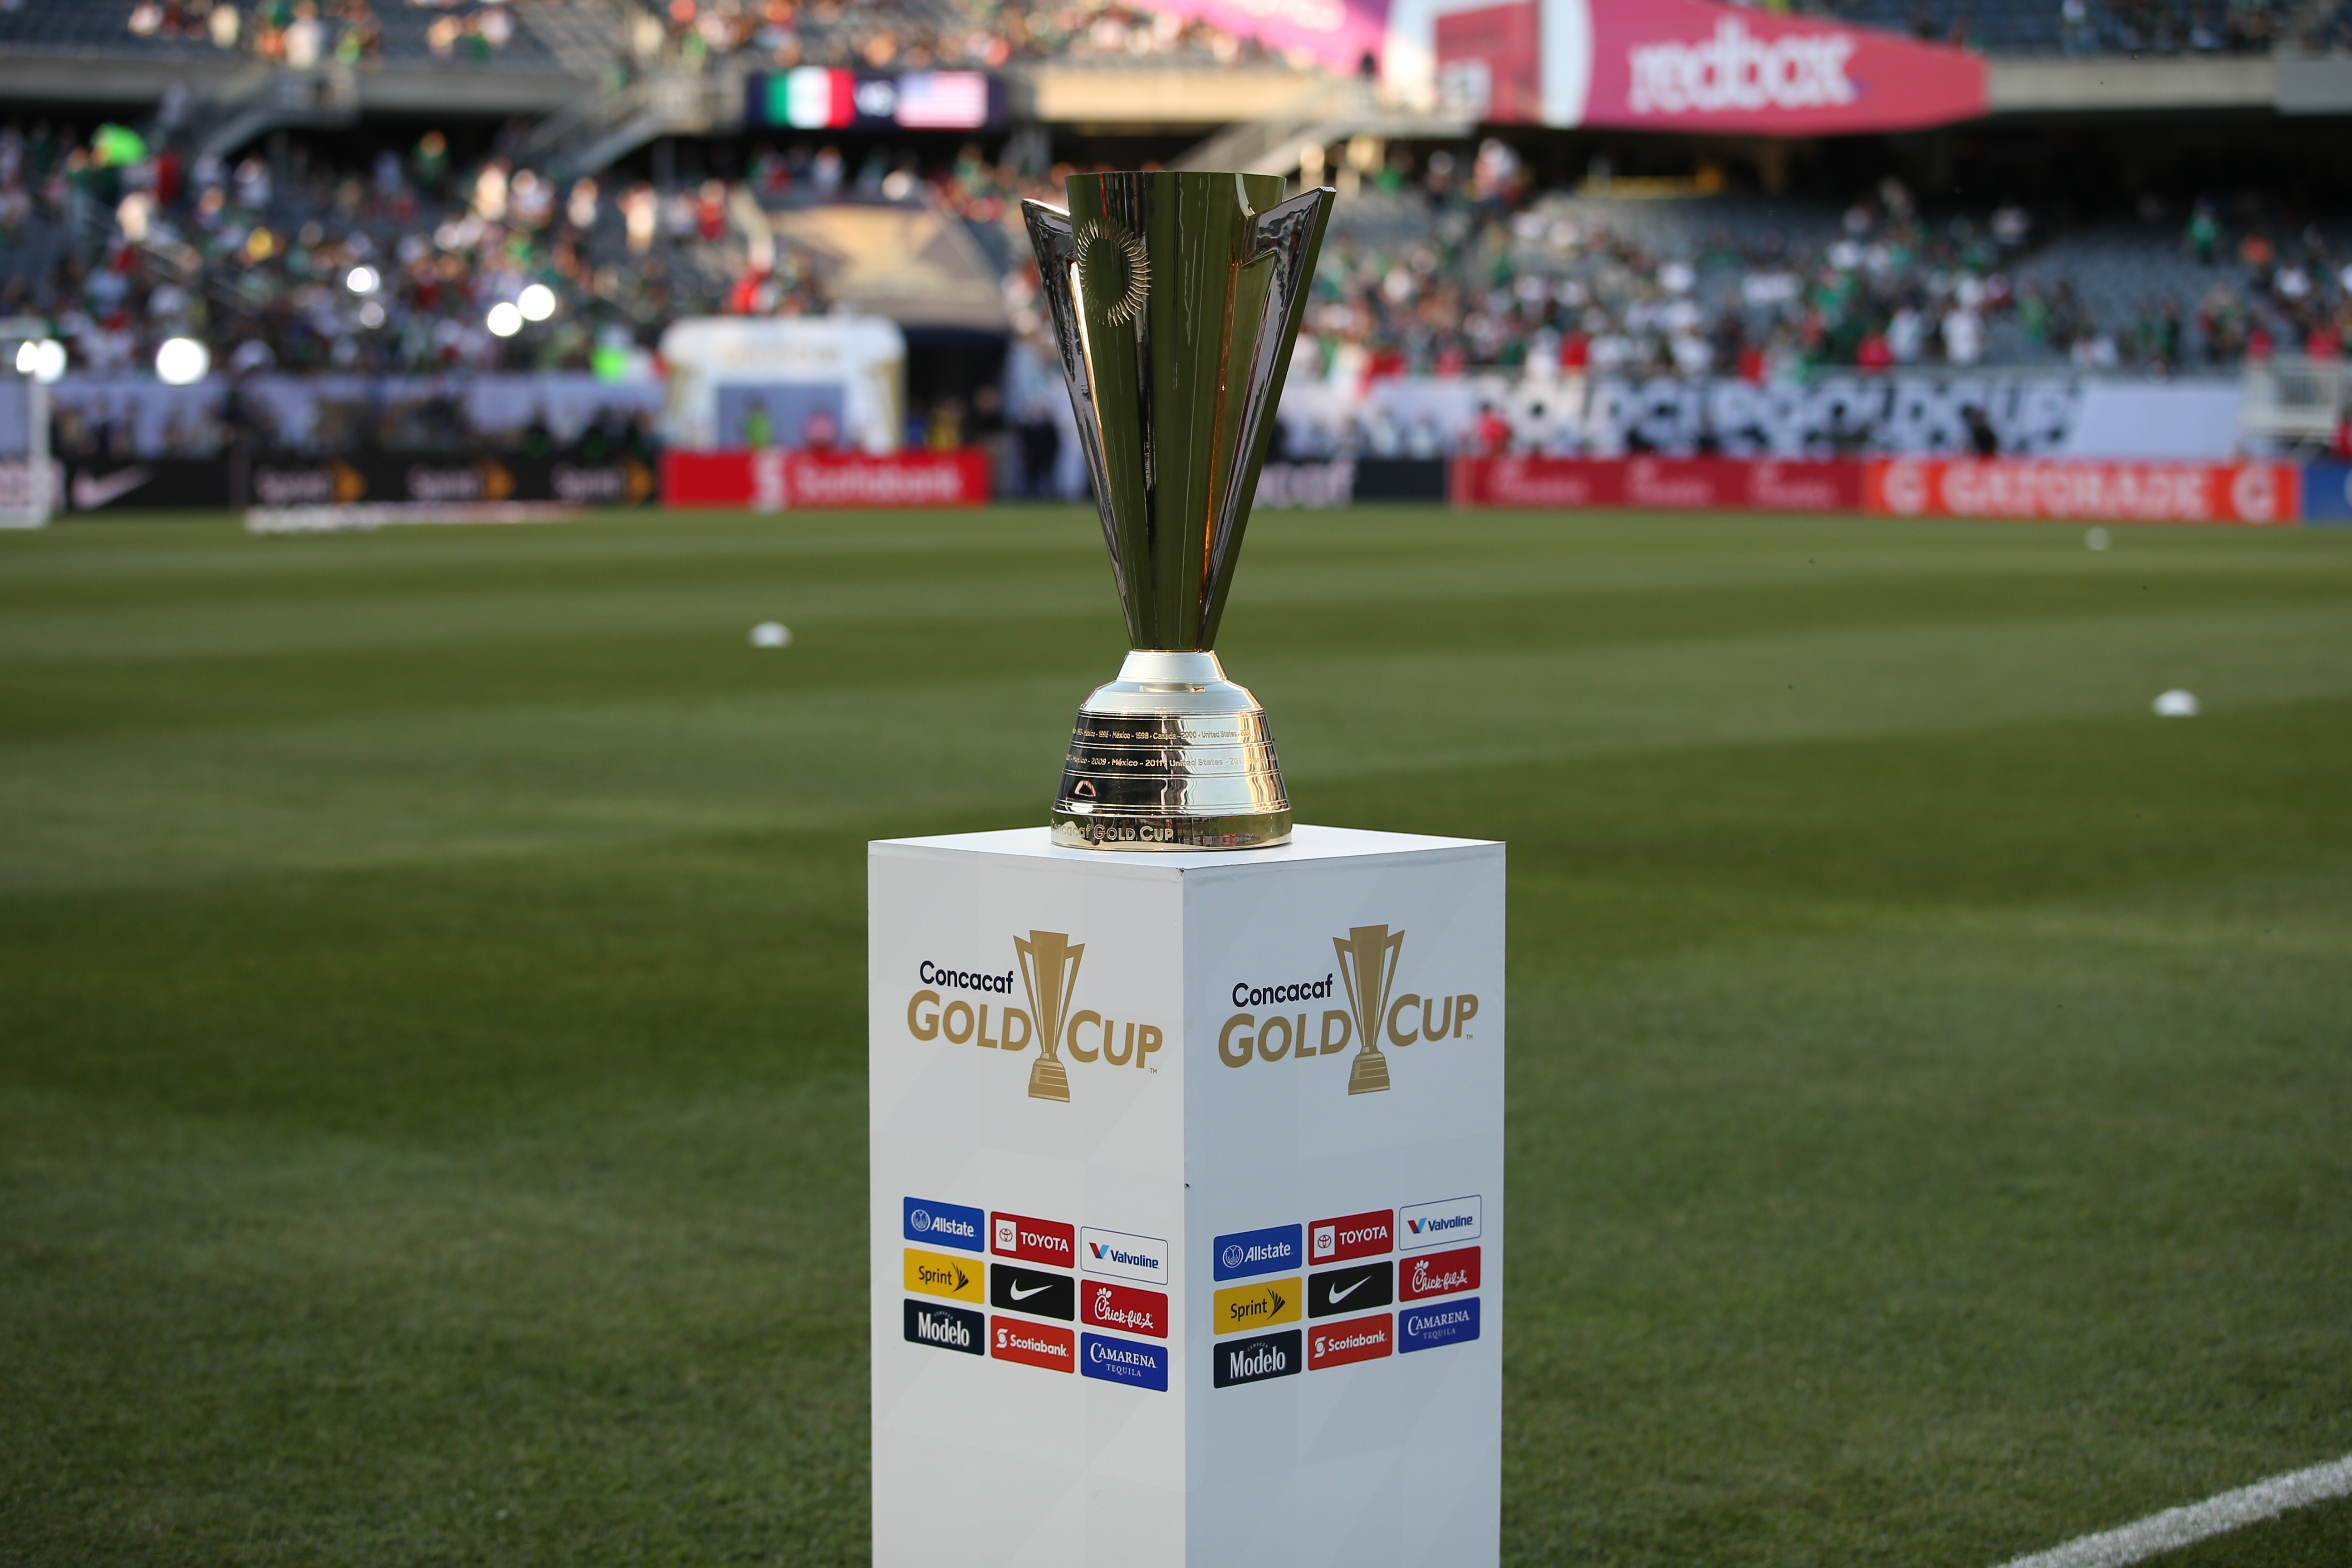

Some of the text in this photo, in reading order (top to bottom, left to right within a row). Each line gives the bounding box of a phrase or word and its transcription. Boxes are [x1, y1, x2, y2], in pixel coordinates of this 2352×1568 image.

[1628, 16, 1858, 113] redbox
[1941, 460, 2217, 519] GATORADE
[1153, 731, 1177, 740] Canada
[1091, 757, 1107, 765] 2009
[1112, 758, 1138, 766] México
[1169, 759, 1196, 767] United
[1093, 824, 1136, 841] GOLD
[1139, 825, 1174, 841] CUP
[920, 960, 1014, 994] Concacaf
[1232, 973, 1333, 1008] Concacaf
[907, 990, 1032, 1052] GOLD
[1067, 1010, 1163, 1069] CUP
[1218, 1009, 1352, 1068] GOLD
[1387, 994, 1479, 1047] CUP
[931, 1216, 975, 1238] Allstate
[1428, 1216, 1473, 1232] Valvoline
[1020, 1231, 1069, 1252] TOYOTA
[1339, 1226, 1388, 1245] TOYOTA
[1110, 1250, 1159, 1269] Valvoline
[1245, 1242, 1291, 1263] Allstate
[919, 1265, 952, 1285] Sprint
[1412, 1267, 1468, 1293] Chick-fil-A
[1094, 1294, 1154, 1329] Chick-fil-A
[1230, 1298, 1267, 1322] Sprint
[918, 1312, 970, 1347] Modelo
[1407, 1310, 1470, 1336] CAMARENA
[1423, 1328, 1456, 1339] TEQUILA
[1009, 1334, 1068, 1357] Scotiabank
[1247, 1342, 1268, 1352] CERVEZA
[1328, 1330, 1385, 1352] Scotiabank
[1090, 1342, 1156, 1368] CAMARENA
[1230, 1346, 1286, 1379] Modelo
[1106, 1363, 1142, 1377] TEQUILA
